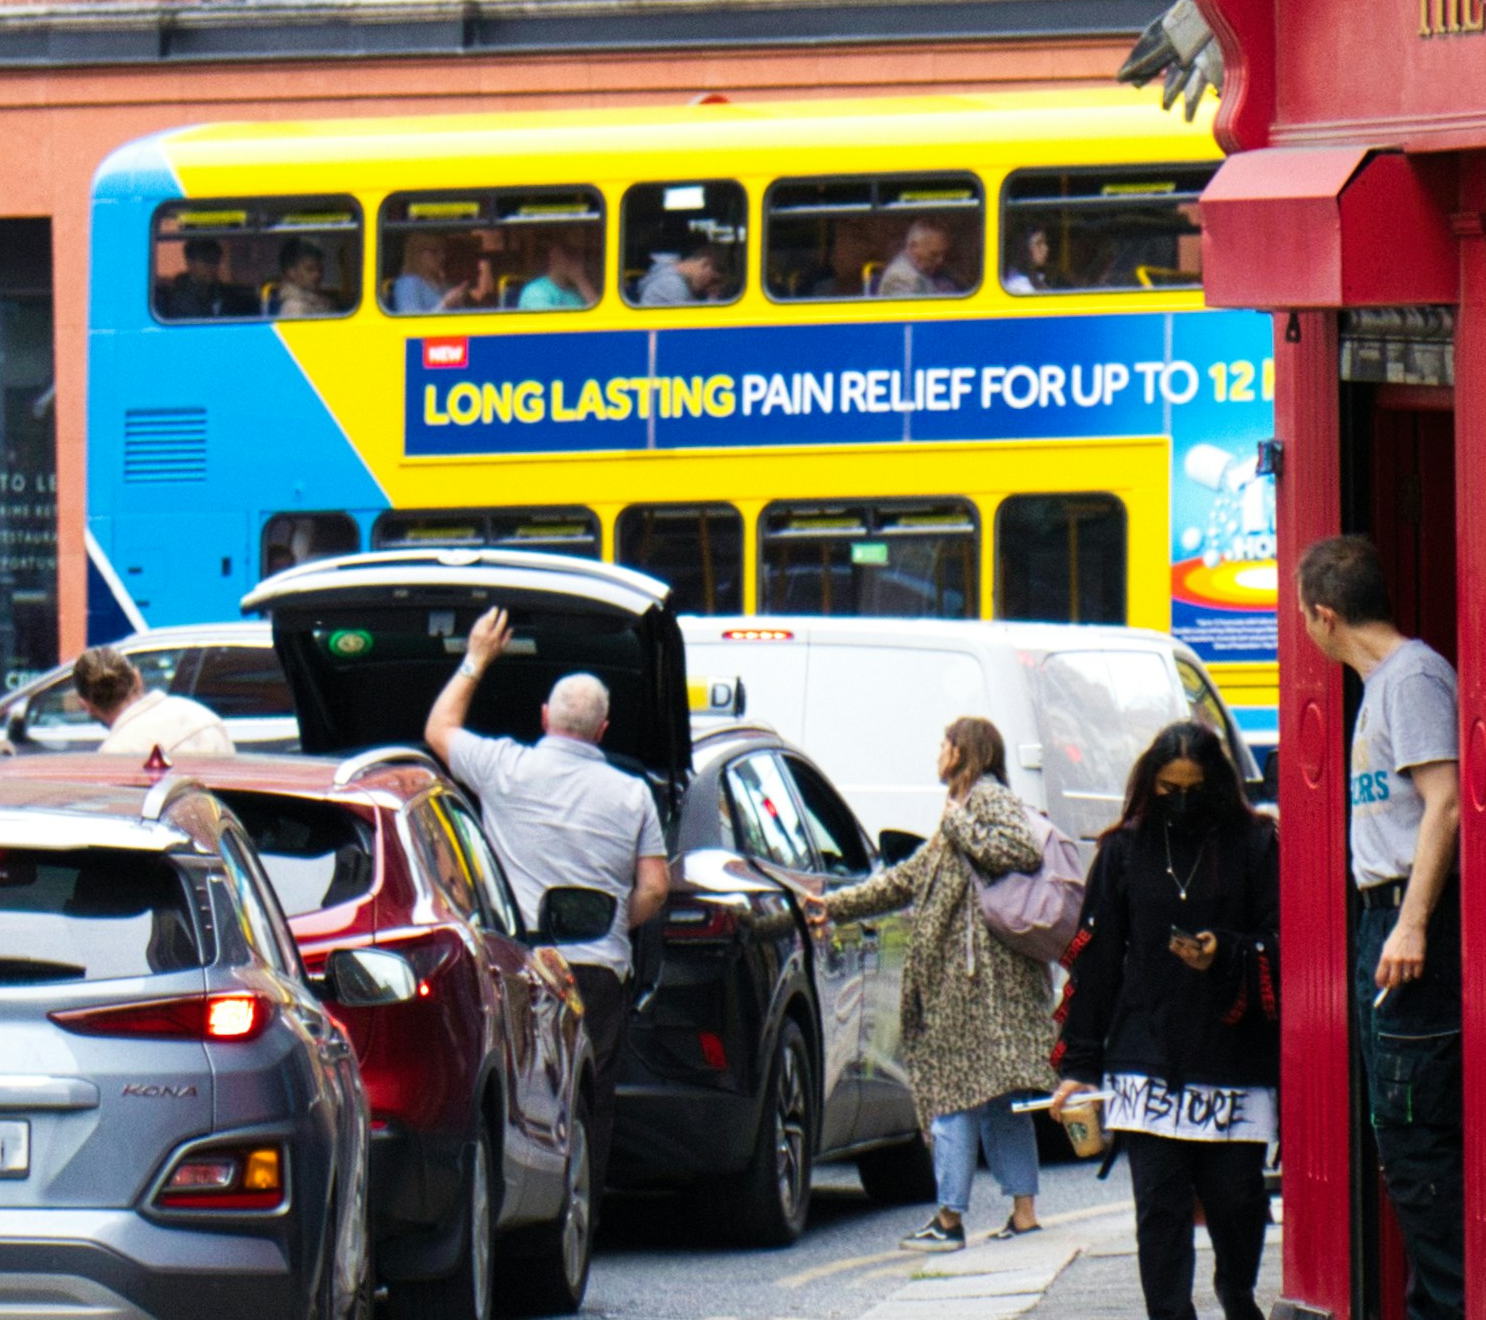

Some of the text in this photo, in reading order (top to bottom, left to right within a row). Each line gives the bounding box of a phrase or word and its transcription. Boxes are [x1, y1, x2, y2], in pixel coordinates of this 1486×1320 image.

[428, 345, 464, 362] NEW
[422, 380, 546, 426] LONG
[551, 374, 737, 422] LASTING
[741, 370, 836, 417] PAIN
[842, 366, 977, 414] RELIEF
[980, 364, 1067, 410] FOR
[1070, 363, 1131, 409] UP
[1134, 359, 1200, 406] TO
[1209, 359, 1256, 404] 12
[36, 474, 57, 493] LE
[121, 1083, 199, 1098] KONA
